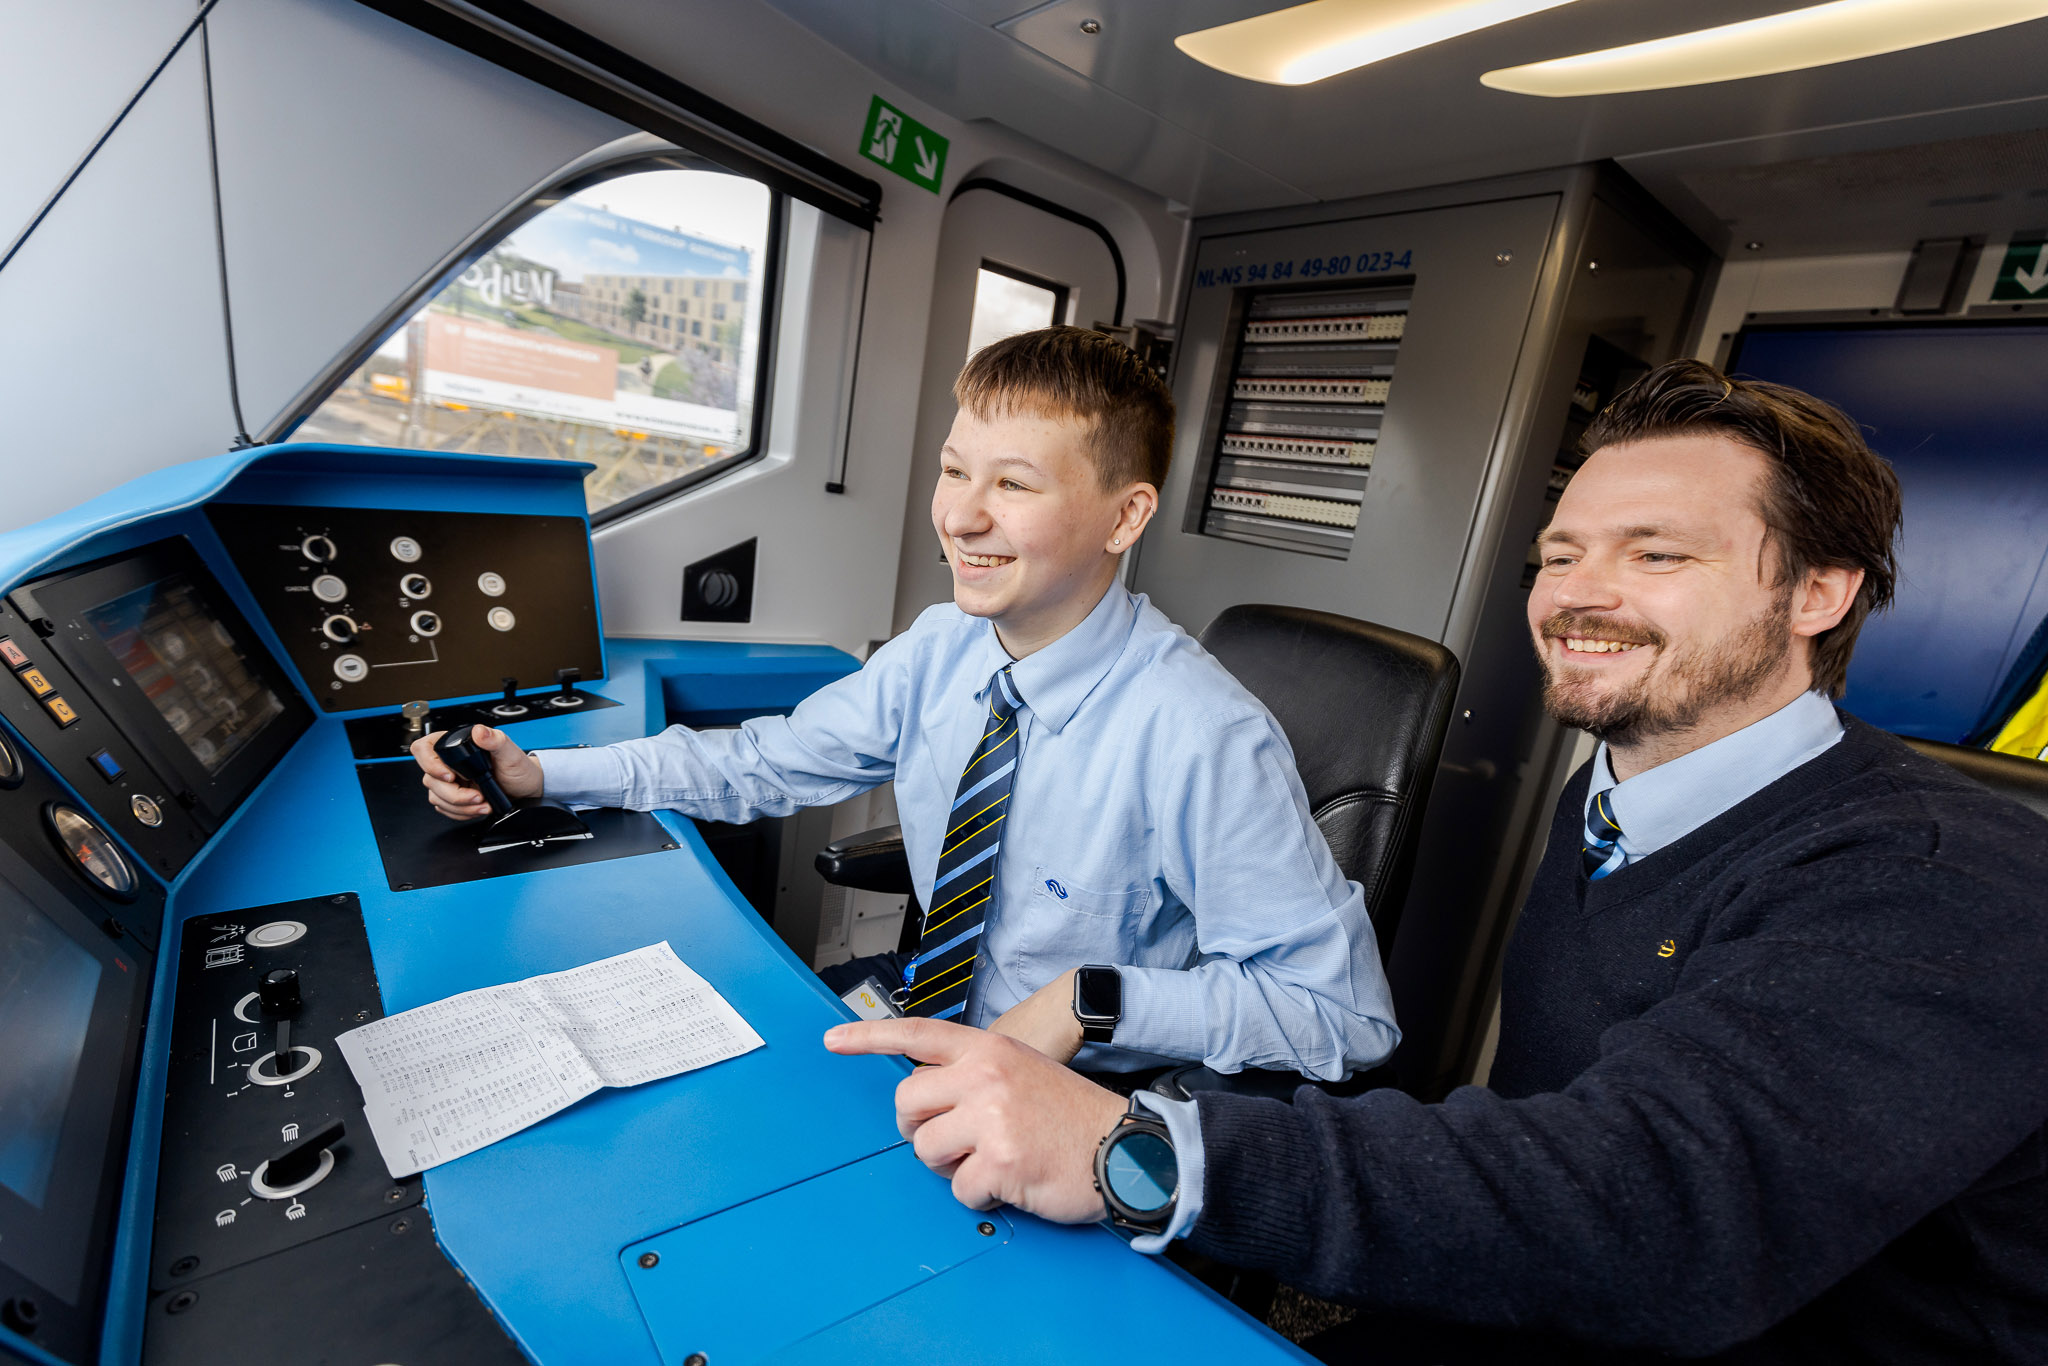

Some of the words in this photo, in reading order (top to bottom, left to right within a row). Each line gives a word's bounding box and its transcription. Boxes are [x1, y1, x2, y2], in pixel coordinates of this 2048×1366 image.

[1197, 266, 1243, 288] NL-NS
[1248, 264, 1268, 282] 94
[1271, 260, 1294, 280] 84
[1300, 255, 1351, 277] 49-80
[1356, 250, 1413, 273] 023-4
[31, 675, 44, 687] B
